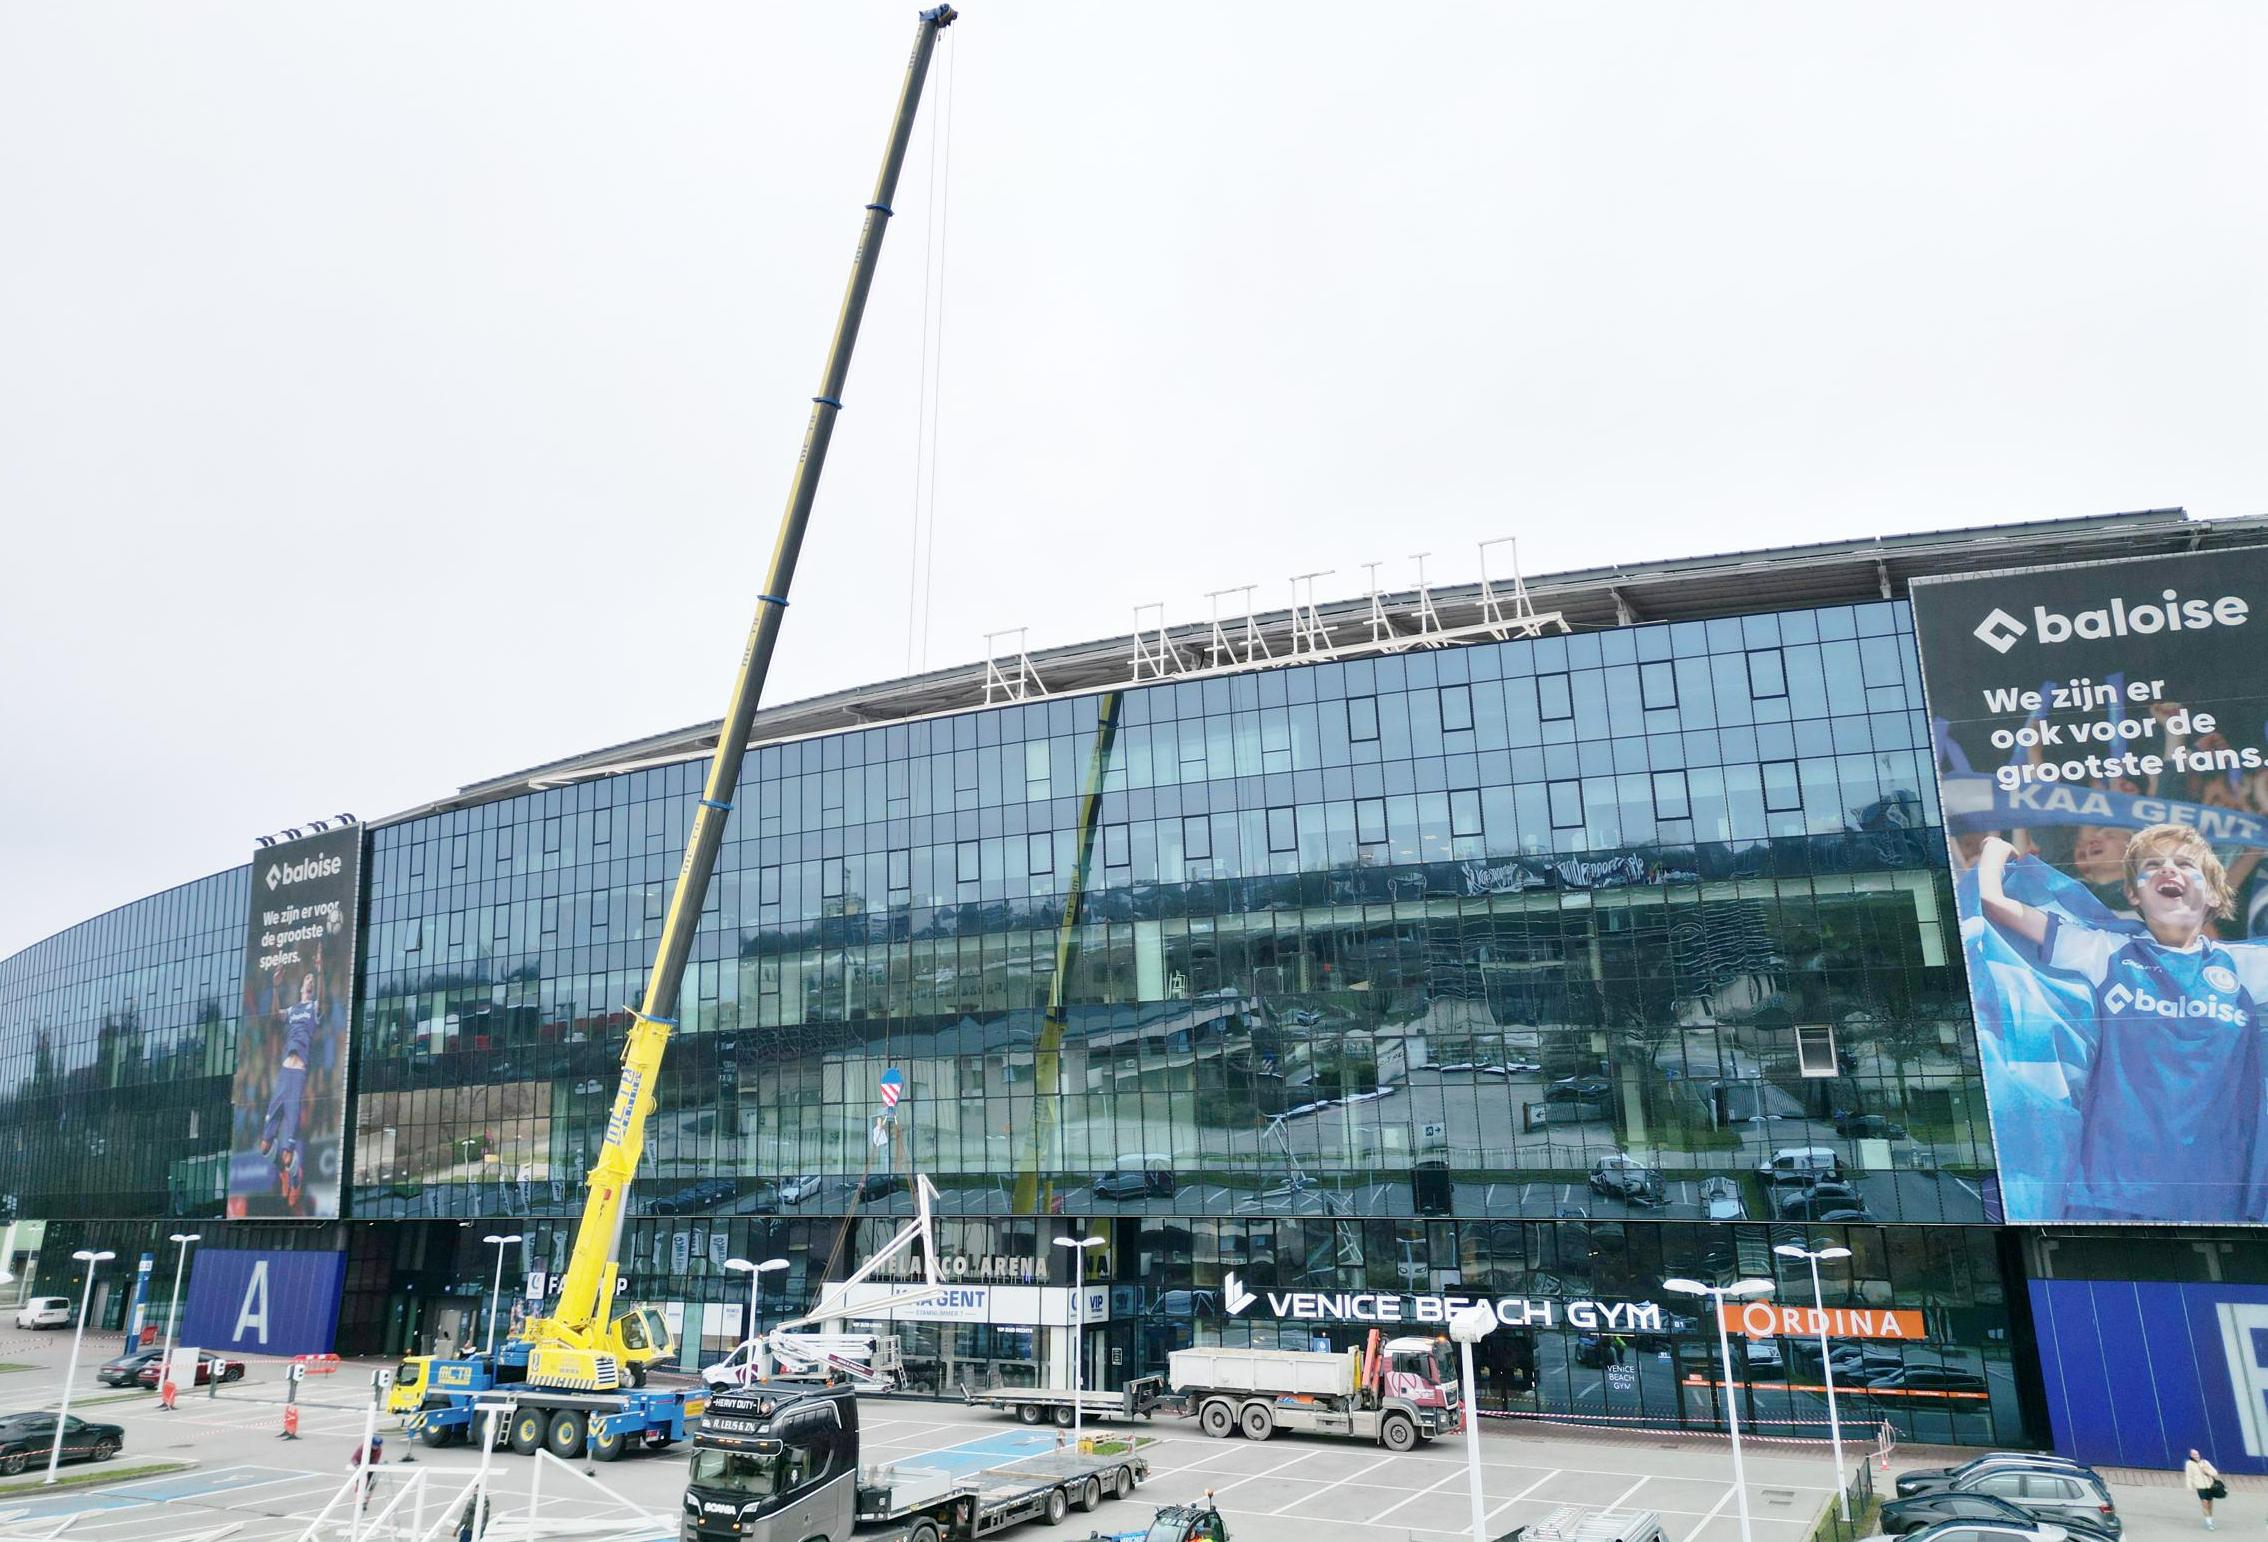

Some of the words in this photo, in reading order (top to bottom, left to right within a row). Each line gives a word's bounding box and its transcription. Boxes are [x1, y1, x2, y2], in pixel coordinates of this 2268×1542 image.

[2033, 589, 2249, 644] baloise
[1983, 687, 2042, 713] We
[2051, 677, 2118, 712] zijn
[2127, 679, 2165, 701] er
[1990, 720, 2062, 749] ook
[2068, 716, 2157, 743] voor
[2165, 708, 2216, 735] de
[1996, 751, 2164, 791] grootste
[2171, 745, 2268, 773] fans.
[2009, 783, 2114, 818] KAA
[2131, 799, 2262, 839] GENT
[282, 852, 342, 885] baloise
[263, 910, 279, 926] We
[281, 904, 300, 925] zijn
[301, 905, 313, 919] er
[314, 901, 340, 917] voor
[261, 930, 276, 947] de
[277, 923, 324, 948] grootste
[259, 950, 301, 971] spelers.
[2134, 987, 2249, 1027] baloise
[980, 1257, 1047, 1277] ARENA
[232, 1260, 268, 1344] A
[937, 1290, 985, 1308] GENT
[1090, 1295, 1103, 1308] VIP
[1267, 1292, 1401, 1321] VENICE
[1568, 1301, 1661, 1330] GYM
[1743, 1302, 1903, 1336] ORDINA
[1607, 1365, 1635, 1373] VENICE
[1608, 1373, 1635, 1382] BEACH
[1613, 1382, 1631, 1390] GYM
[704, 1502, 737, 1515] SCANIA
